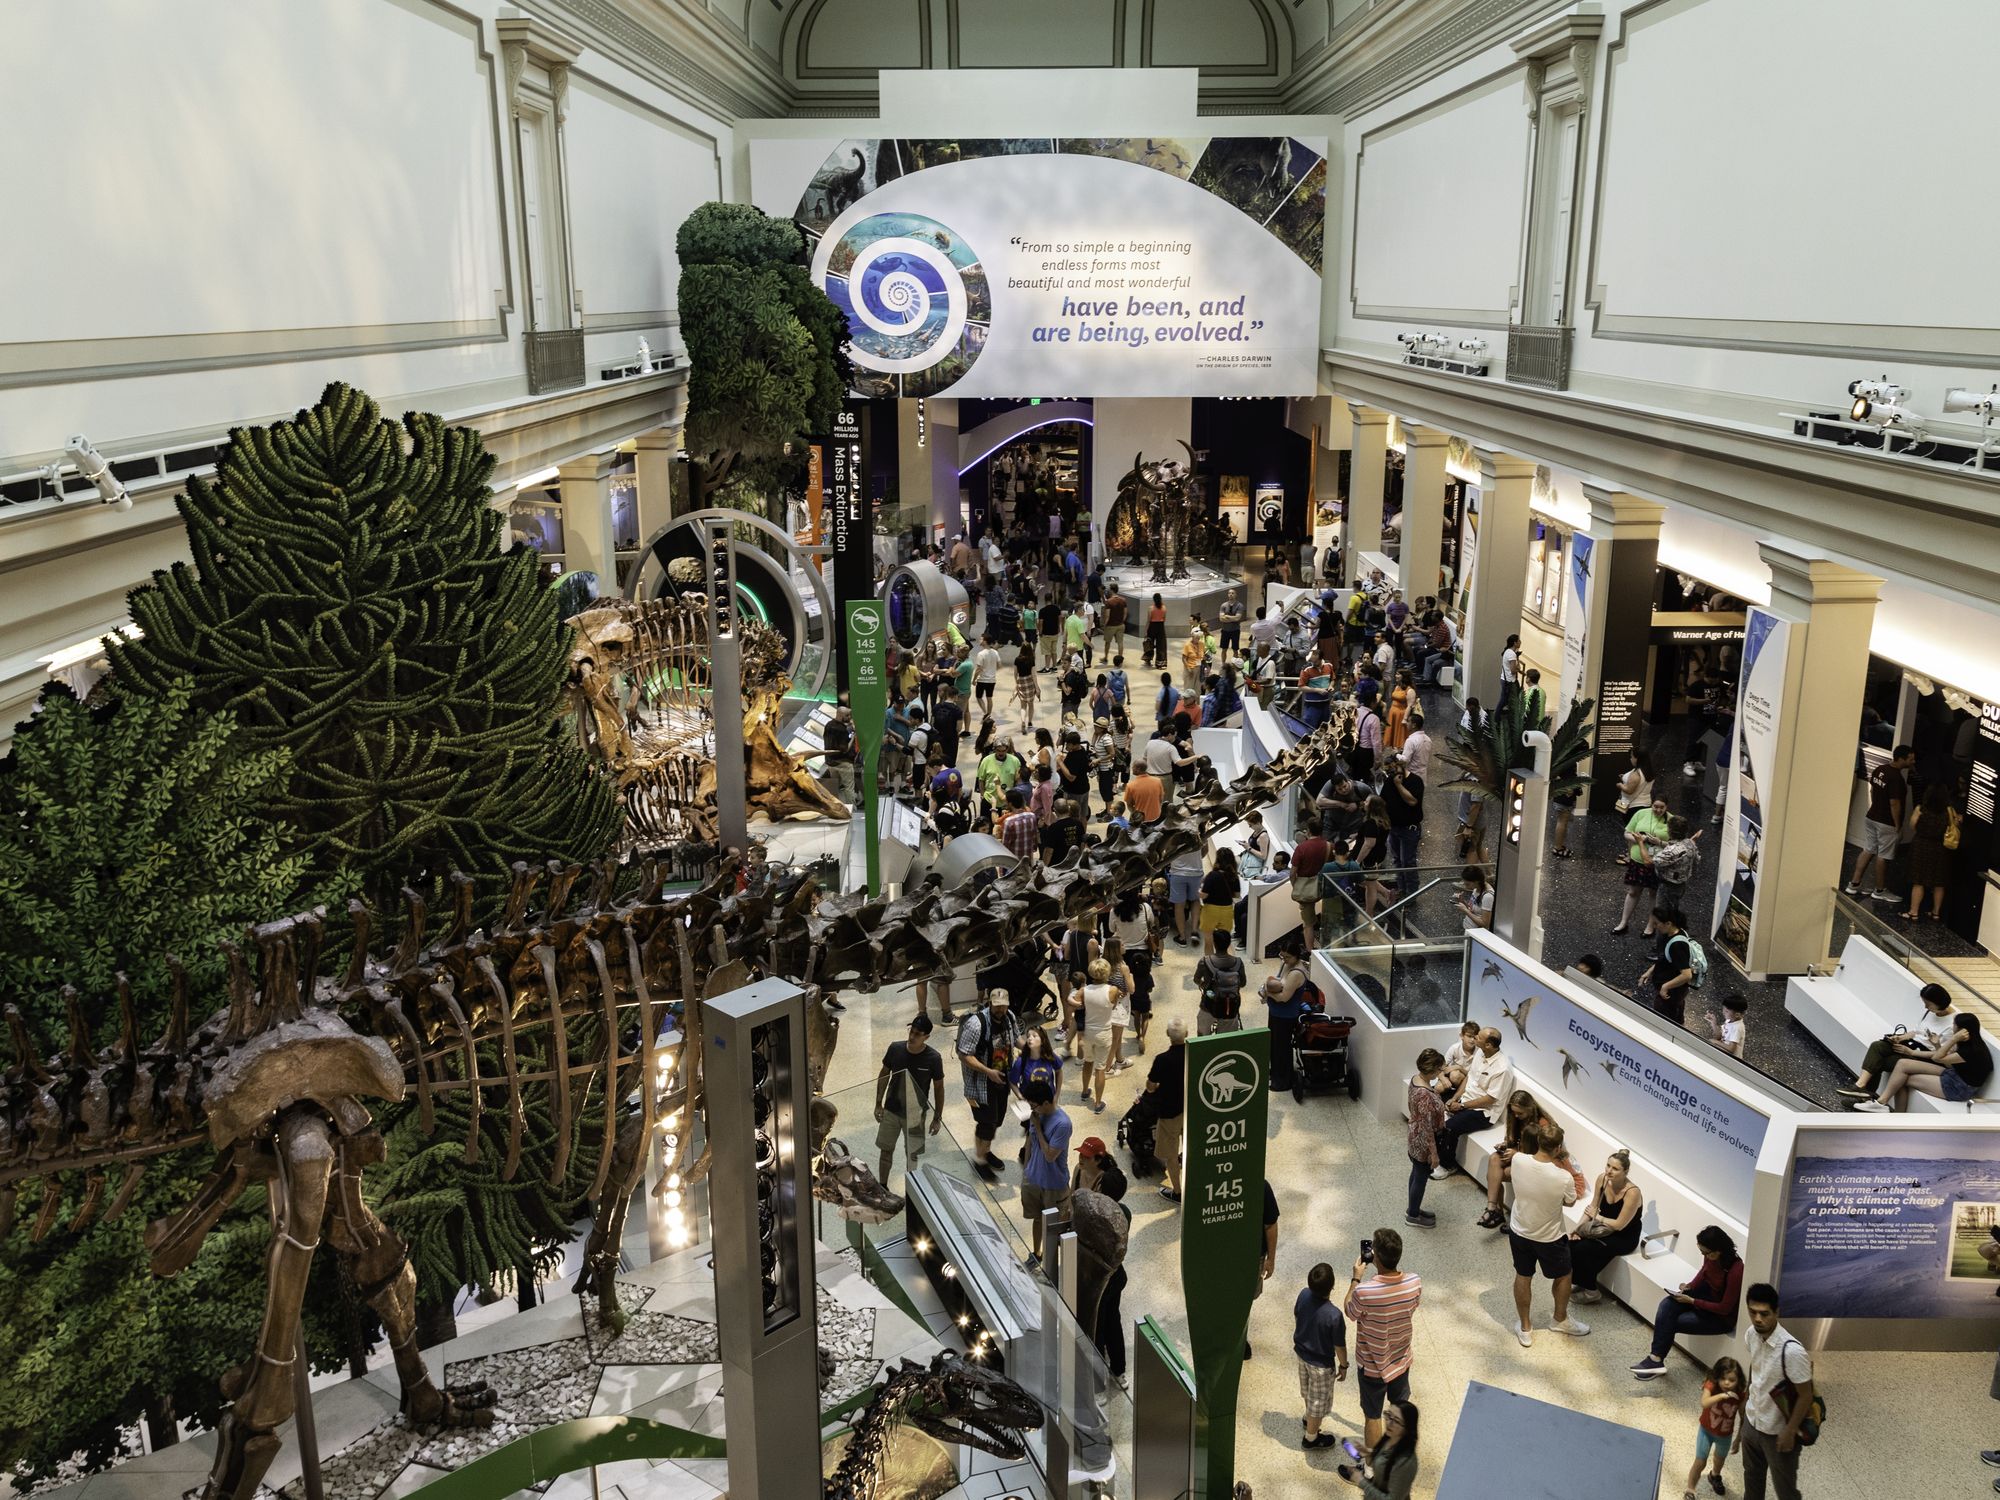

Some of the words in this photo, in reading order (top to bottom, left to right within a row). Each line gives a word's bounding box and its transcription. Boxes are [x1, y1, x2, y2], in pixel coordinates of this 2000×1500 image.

[1056, 243, 1069, 252] so
[1073, 241, 1114, 255] simple
[1118, 243, 1125, 252] a
[1129, 241, 1192, 255] beginning
[1042, 260, 1088, 270] endless
[1091, 260, 1126, 273] forms
[1130, 260, 1160, 270] most
[1008, 277, 1064, 291] beautiful
[1067, 277, 1090, 288] and
[1094, 278, 1124, 288] most
[1128, 276, 1190, 291] wonderful
[1062, 296, 1118, 316] have
[1126, 296, 1190, 320] been,
[1200, 296, 1245, 316] and
[1032, 326, 1070, 342] are
[1078, 320, 1150, 348] being,
[838, 413, 854, 424] 66
[835, 447, 845, 481] Mass
[836, 485, 848, 552] Extinction
[1705, 631, 1721, 640] Age
[856, 639, 875, 648] 145
[860, 666, 874, 674] 66
[1749, 692, 1759, 703] Deep
[1760, 698, 1770, 708] Time
[1568, 1019, 1642, 1073] Ecosystems
[1645, 1068, 1698, 1107] change
[1701, 1103, 1711, 1115] as
[1713, 1110, 1730, 1125] the
[1620, 1068, 1641, 1087] Earth
[1644, 1084, 1679, 1111] changes
[1682, 1108, 1700, 1124] and
[1702, 1118, 1716, 1134] life
[1718, 1130, 1757, 1158] evolves.
[1206, 1118, 1246, 1144] 201
[1205, 1142, 1247, 1157] MILLION
[1216, 1162, 1233, 1174] TO
[1205, 1178, 1243, 1202] 145
[1907, 1187, 1932, 1196] past.
[1202, 1201, 1244, 1216] MILLION
[1817, 1196, 1843, 1206] Why
[1844, 1196, 1854, 1204] is
[1856, 1196, 1900, 1204] climate
[1902, 1196, 1945, 1207] change
[1202, 1215, 1226, 1225] YEARS
[1227, 1211, 1243, 1221] AGO
[1819, 1206, 1867, 1216] problem
[1869, 1206, 1901, 1215] now?
